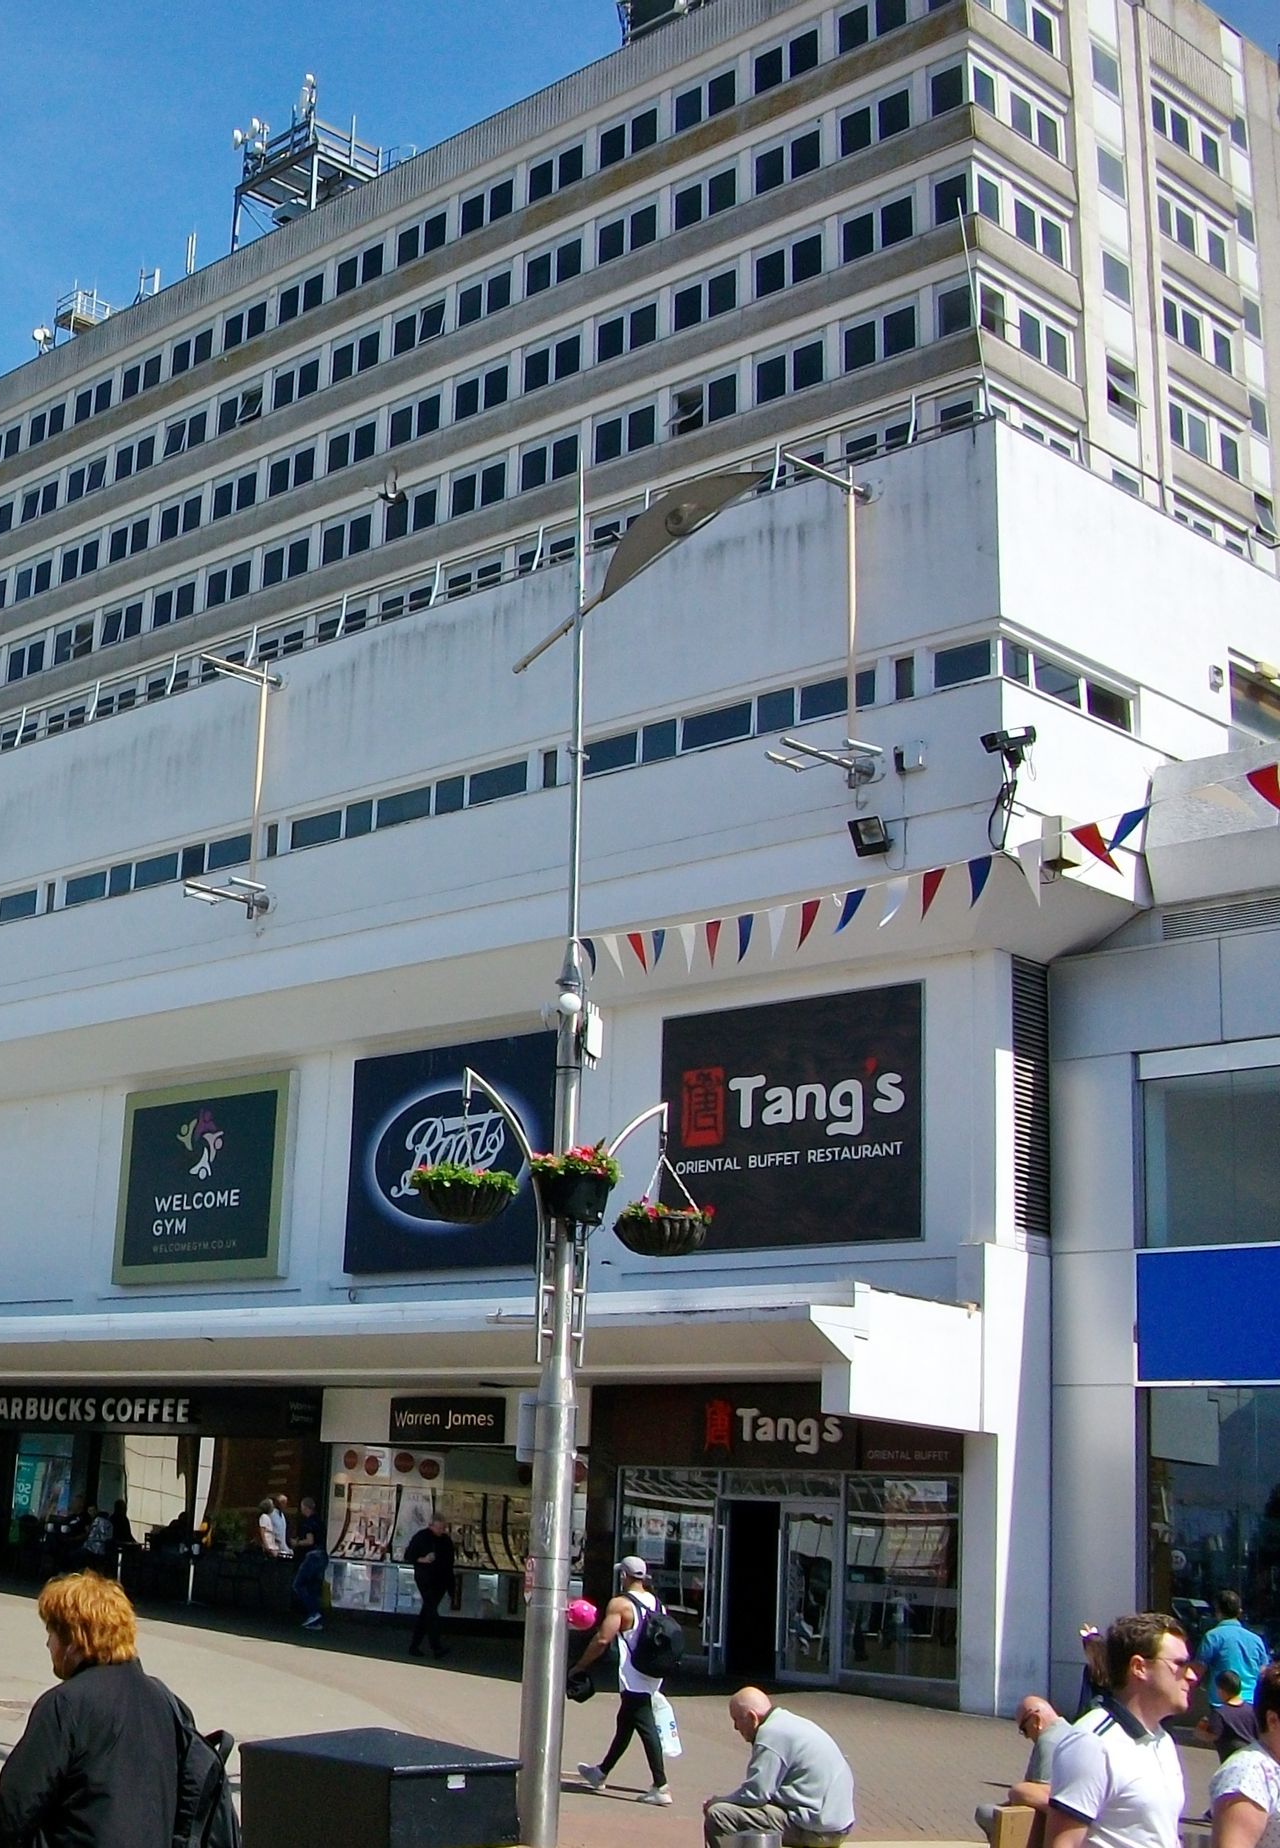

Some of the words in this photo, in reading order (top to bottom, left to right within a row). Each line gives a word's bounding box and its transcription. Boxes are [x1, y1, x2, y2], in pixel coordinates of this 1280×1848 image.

[728, 1057, 905, 1136] Tang's
[675, 1157, 741, 1176] ORIENTAL
[748, 1151, 800, 1169] BUFFET
[807, 1141, 903, 1163] RESTAURANT
[155, 1189, 240, 1213] WELCOME
[152, 1217, 187, 1236] GYM
[101, 1398, 190, 1423] COFFEE
[395, 1409, 440, 1427] Warren
[445, 1409, 494, 1429] James
[867, 1450, 911, 1461] ORIENTAL
[914, 1450, 949, 1461] BUFFET
